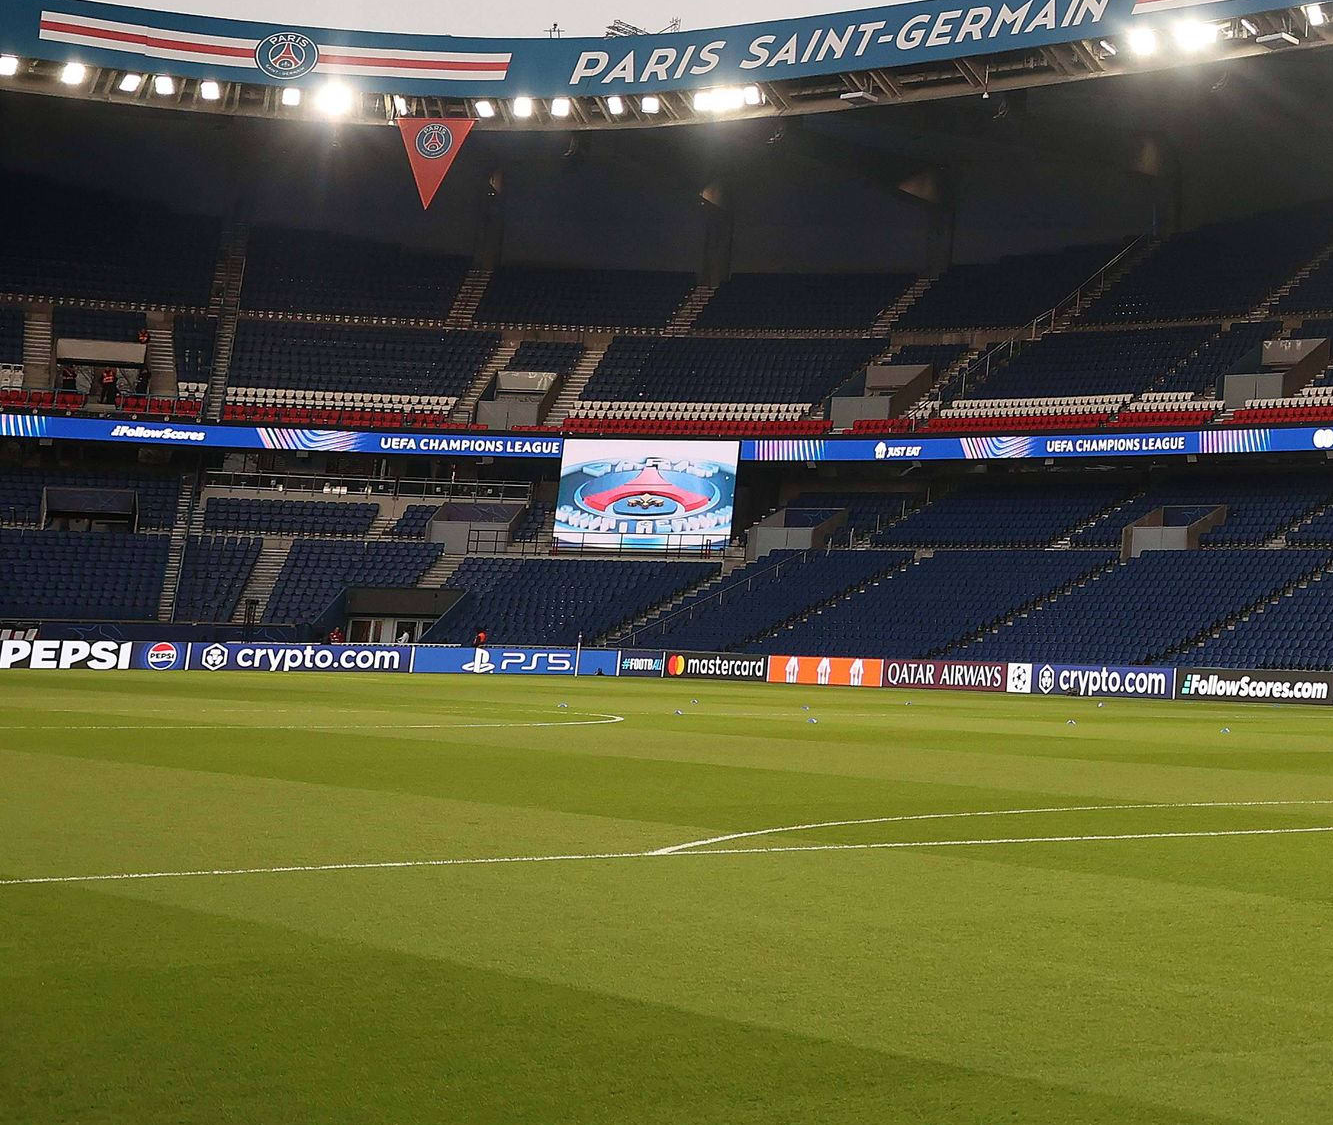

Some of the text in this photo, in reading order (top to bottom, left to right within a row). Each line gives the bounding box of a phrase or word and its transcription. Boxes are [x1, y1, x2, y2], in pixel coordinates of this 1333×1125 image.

[269, 34, 309, 47] PARIS
[568, 40, 726, 85] PARIS
[380, 437, 560, 454] UEFA CHAMPIONS LEAGUE
[886, 446, 921, 458] JUST EAT
[1046, 437, 1185, 453] UEFA CHAMPIONS LEAGUE
[0, 640, 133, 670] PEPSI
[149, 651, 175, 661] PEPSI
[237, 647, 400, 672] crypto.com
[501, 652, 571, 670] PS5
[687, 657, 764, 677] mastercard
[887, 662, 1002, 687] QATAR AIRWAYS
[1059, 667, 1166, 696] crypto.com
[1190, 674, 1329, 699] FollowScores.com
